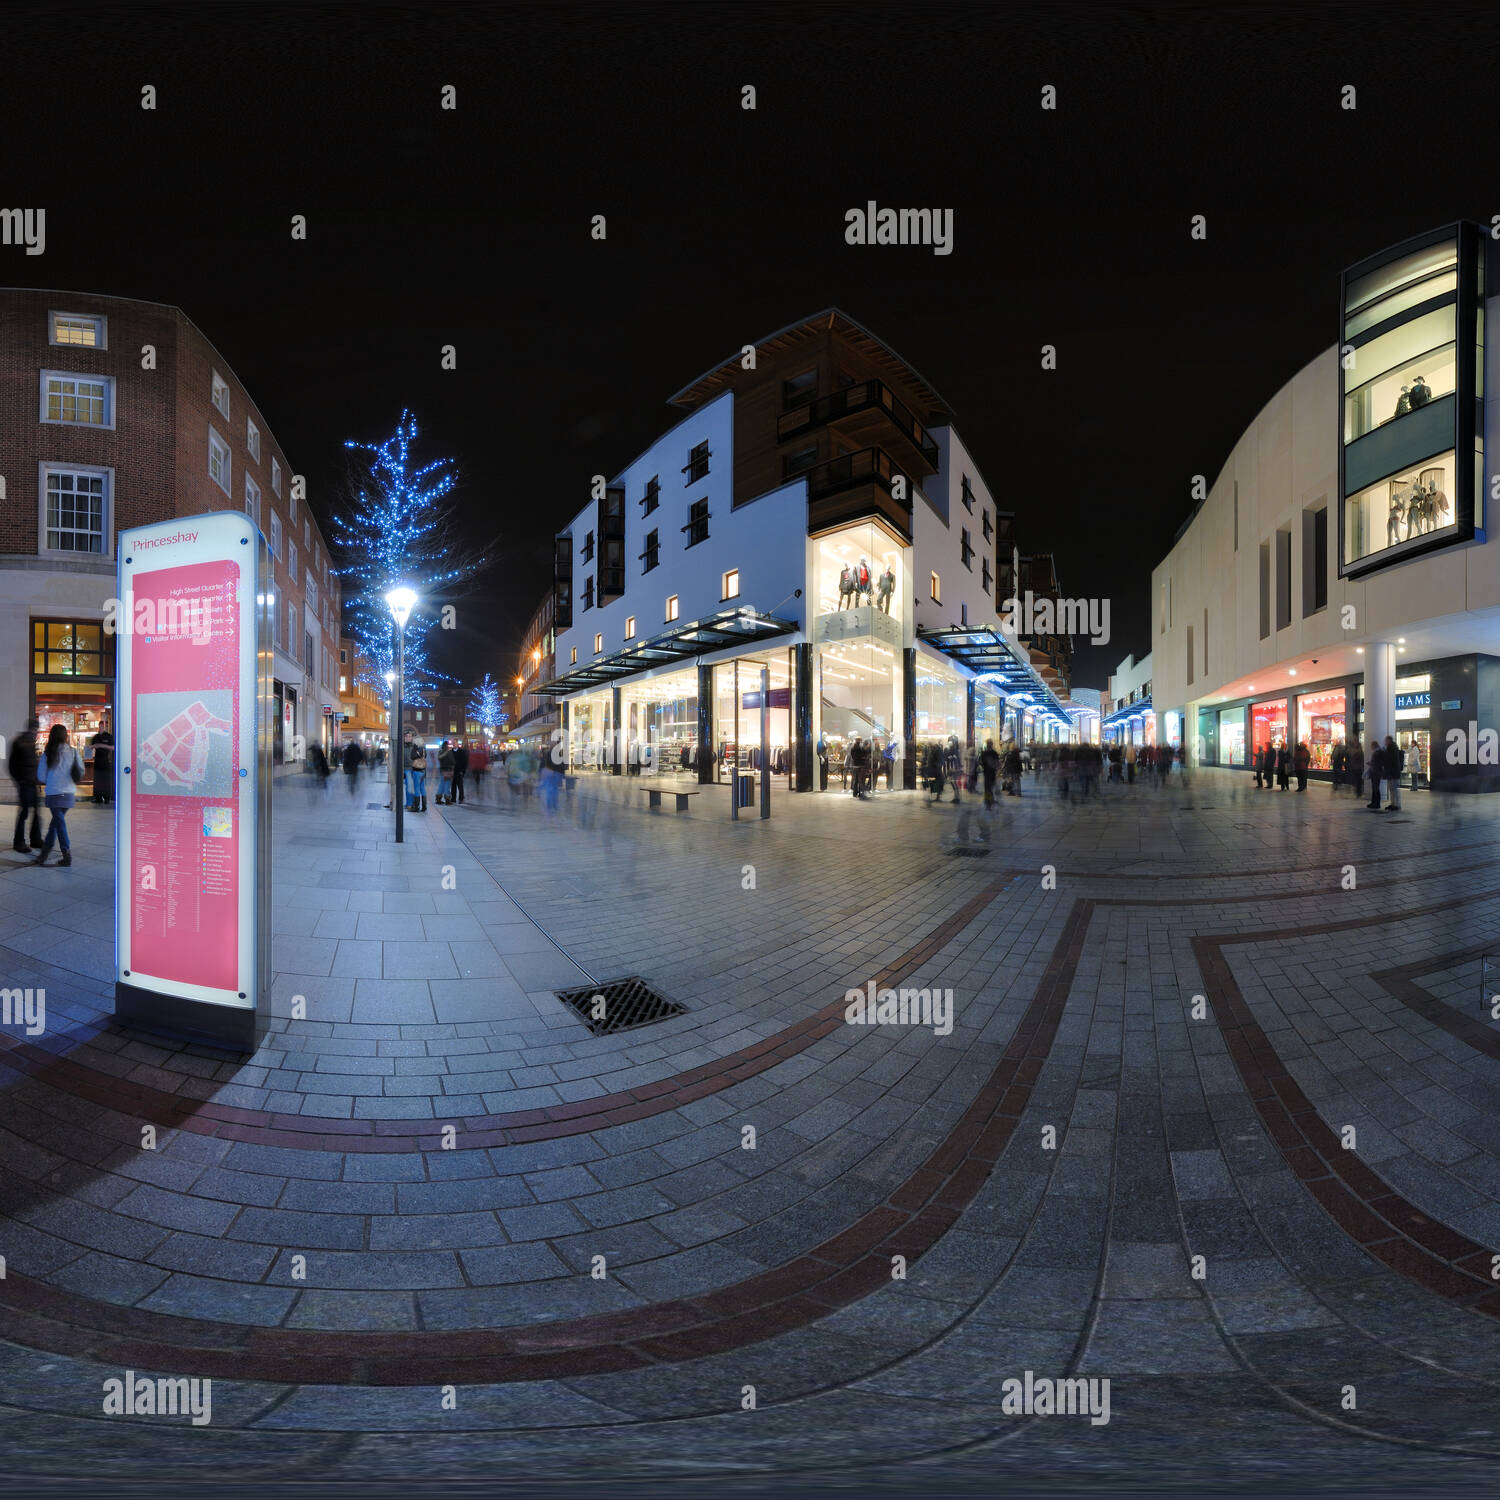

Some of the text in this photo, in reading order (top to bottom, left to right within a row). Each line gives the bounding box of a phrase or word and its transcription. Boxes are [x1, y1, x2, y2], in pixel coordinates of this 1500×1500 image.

[131, 531, 199, 552] Princesshay
[170, 583, 224, 596] High Street Quarter
